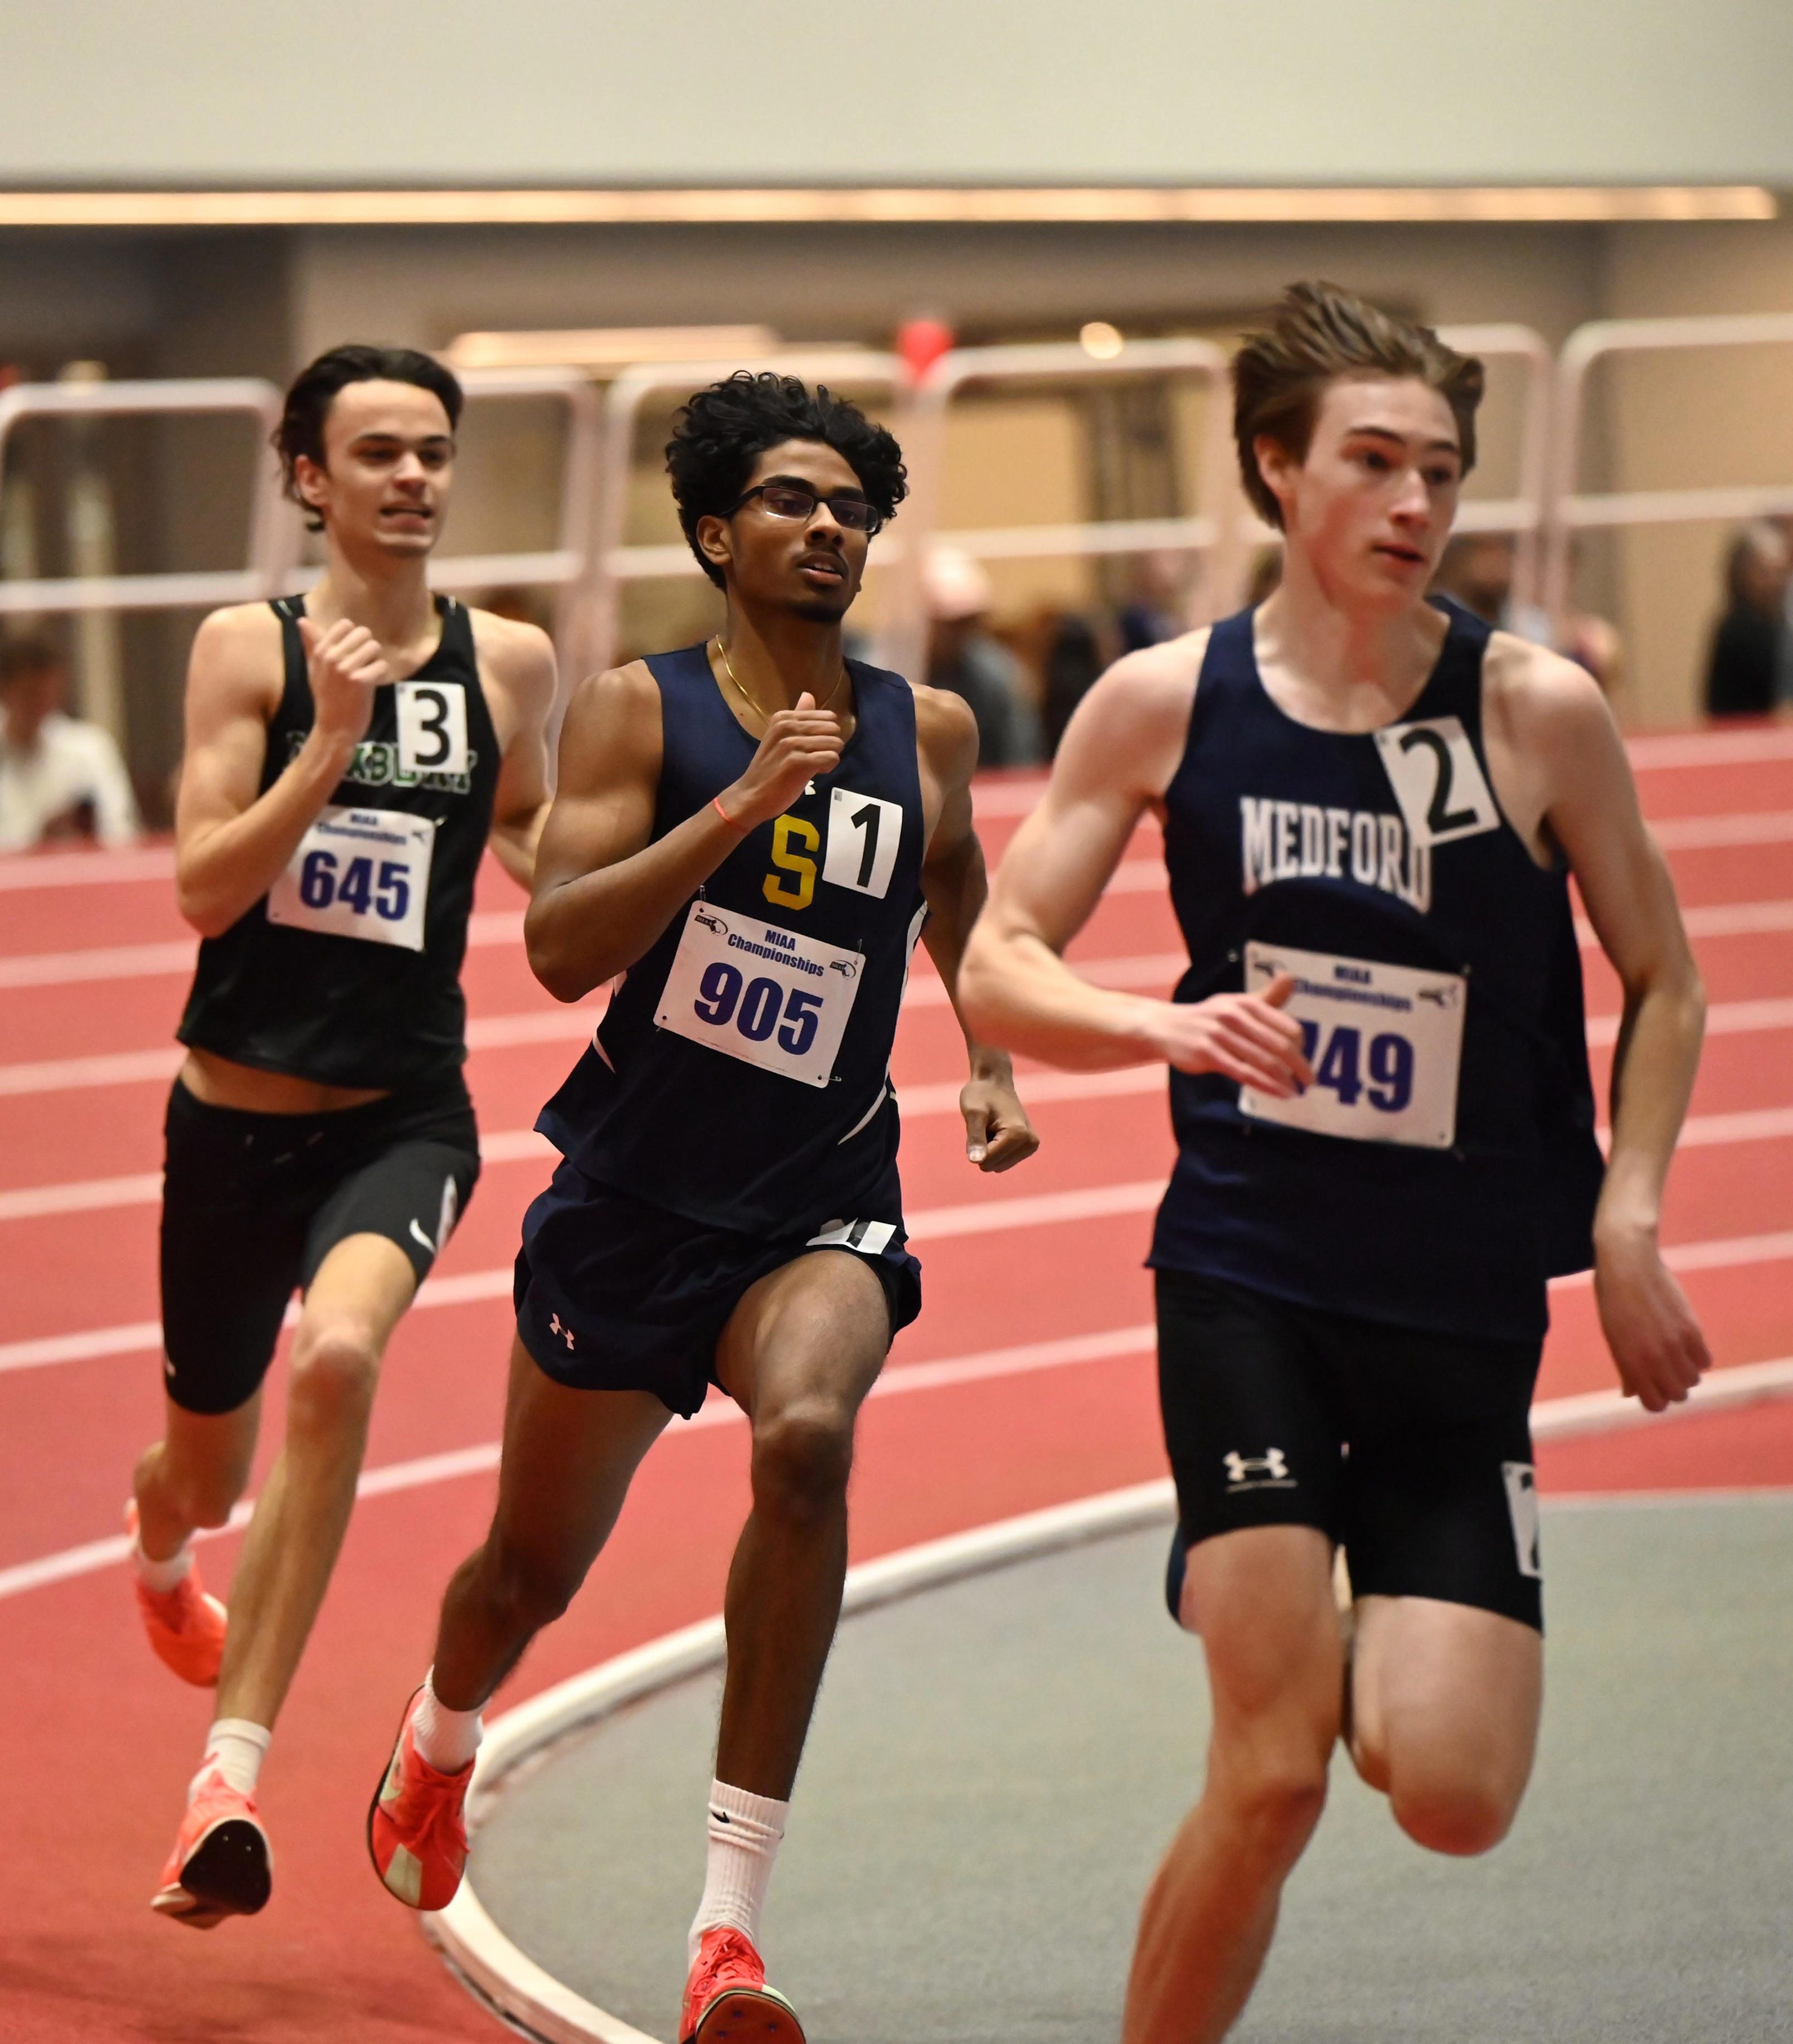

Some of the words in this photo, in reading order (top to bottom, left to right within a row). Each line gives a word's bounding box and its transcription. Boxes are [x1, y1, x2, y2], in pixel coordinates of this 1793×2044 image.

[414, 689, 450, 766] 3
[1400, 727, 1478, 833] 2
[299, 850, 410, 921] 645
[762, 813, 820, 910] S
[851, 803, 881, 887] 1
[1240, 796, 1431, 914] MEDFORD
[727, 934, 824, 977] Championships
[765, 930, 796, 951] MIAA
[693, 962, 824, 1055] 905
